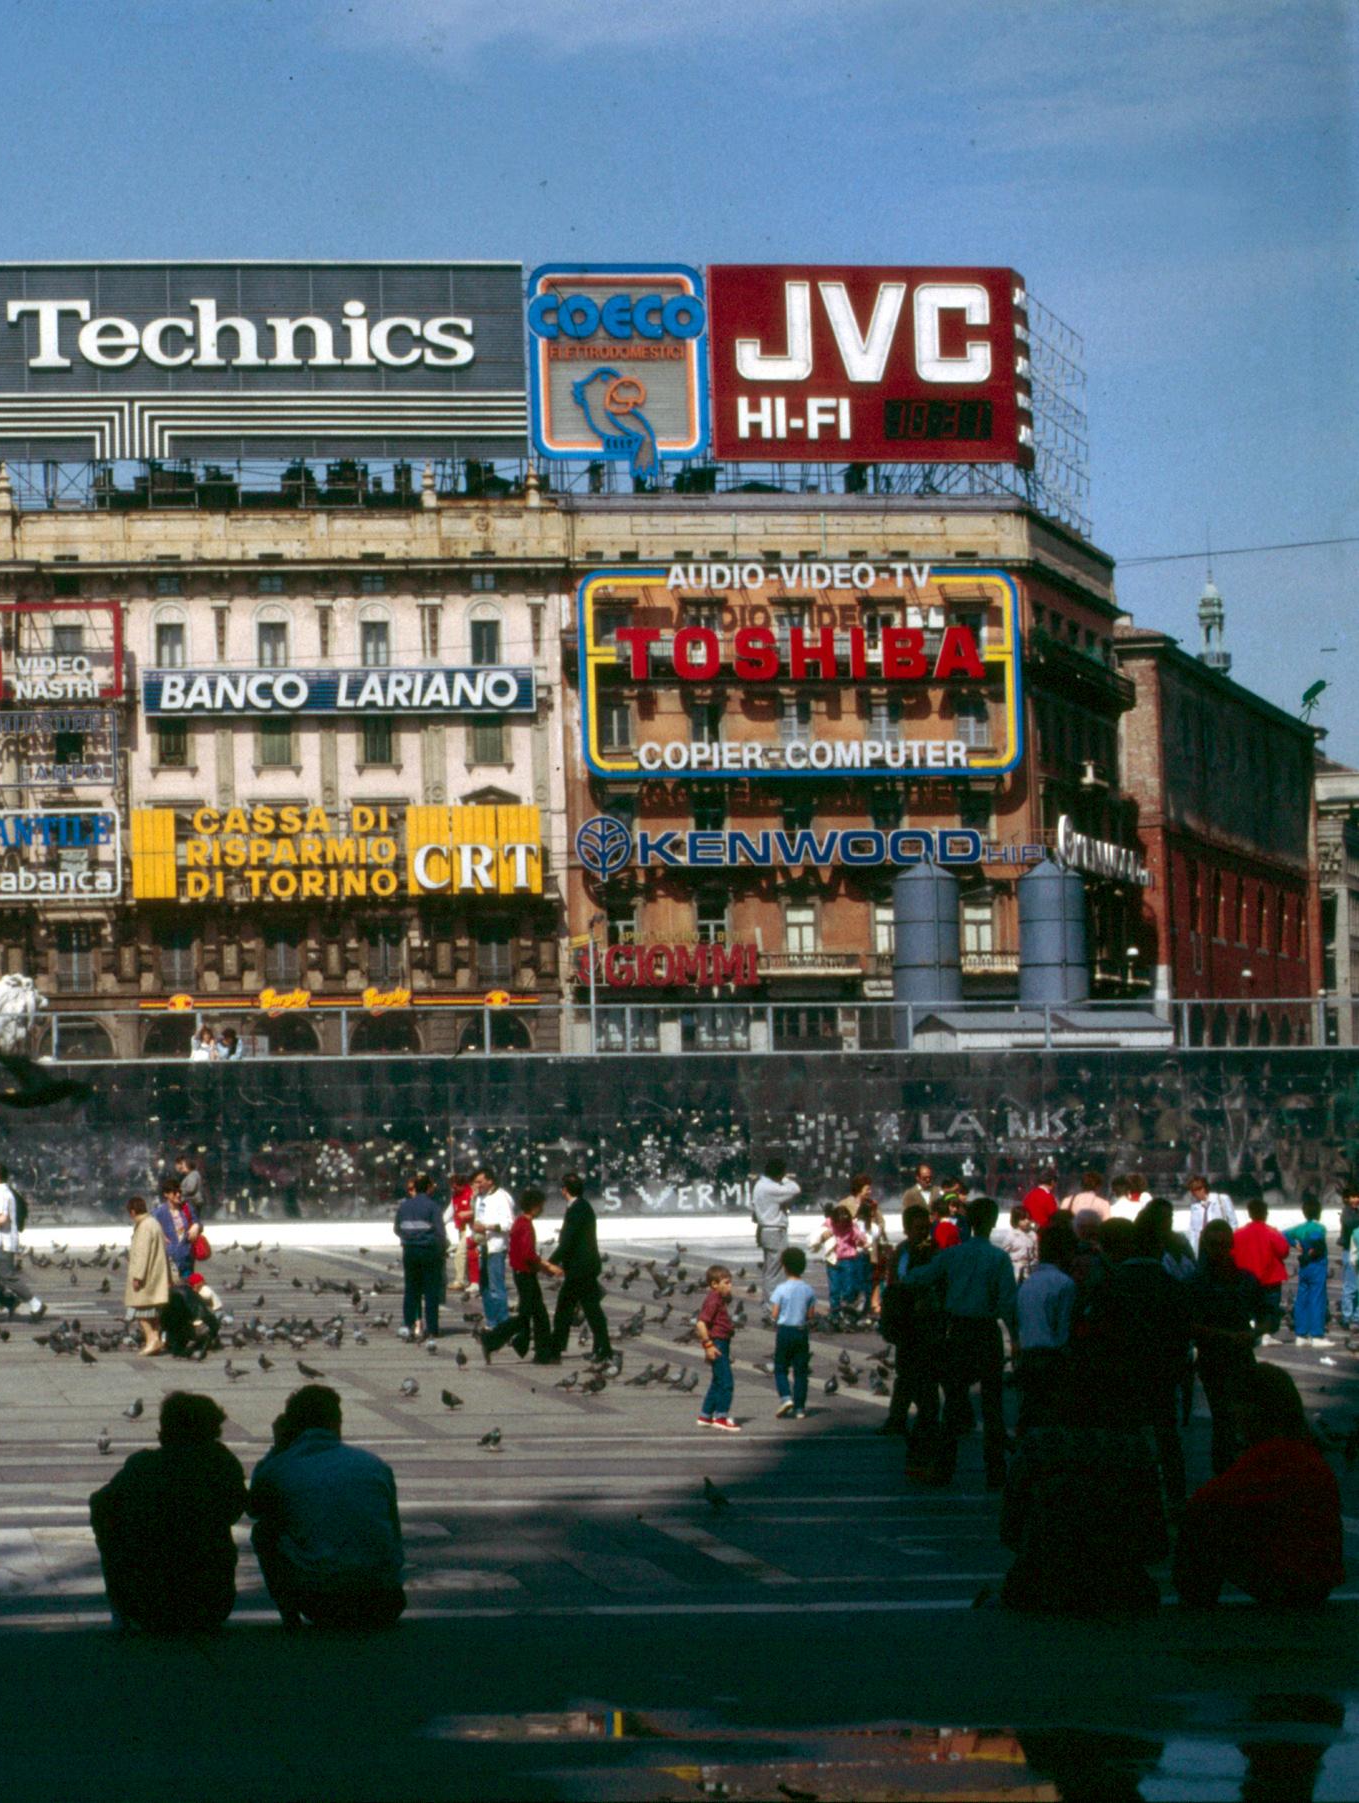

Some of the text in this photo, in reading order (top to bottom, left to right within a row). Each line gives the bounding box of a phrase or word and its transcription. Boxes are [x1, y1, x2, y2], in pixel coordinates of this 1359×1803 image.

[6, 298, 475, 370] Technics
[528, 294, 705, 340] COECO
[735, 281, 991, 384] JVC
[548, 345, 685, 361] ELETTRODOMESTICI
[736, 396, 851, 440] HI-FI
[15, 656, 90, 675] VIDEO
[616, 626, 986, 680] TOSHIBA
[14, 679, 100, 699] NASTRI
[160, 671, 519, 709] BANCO LARIANO
[193, 806, 388, 834] CASSA DI
[186, 837, 397, 866] RISPARMIO
[414, 843, 538, 889] CRT
[636, 829, 983, 865] KENWOOD
[187, 869, 398, 898] DI TORINO
[605, 943, 761, 987] GIOMMI
